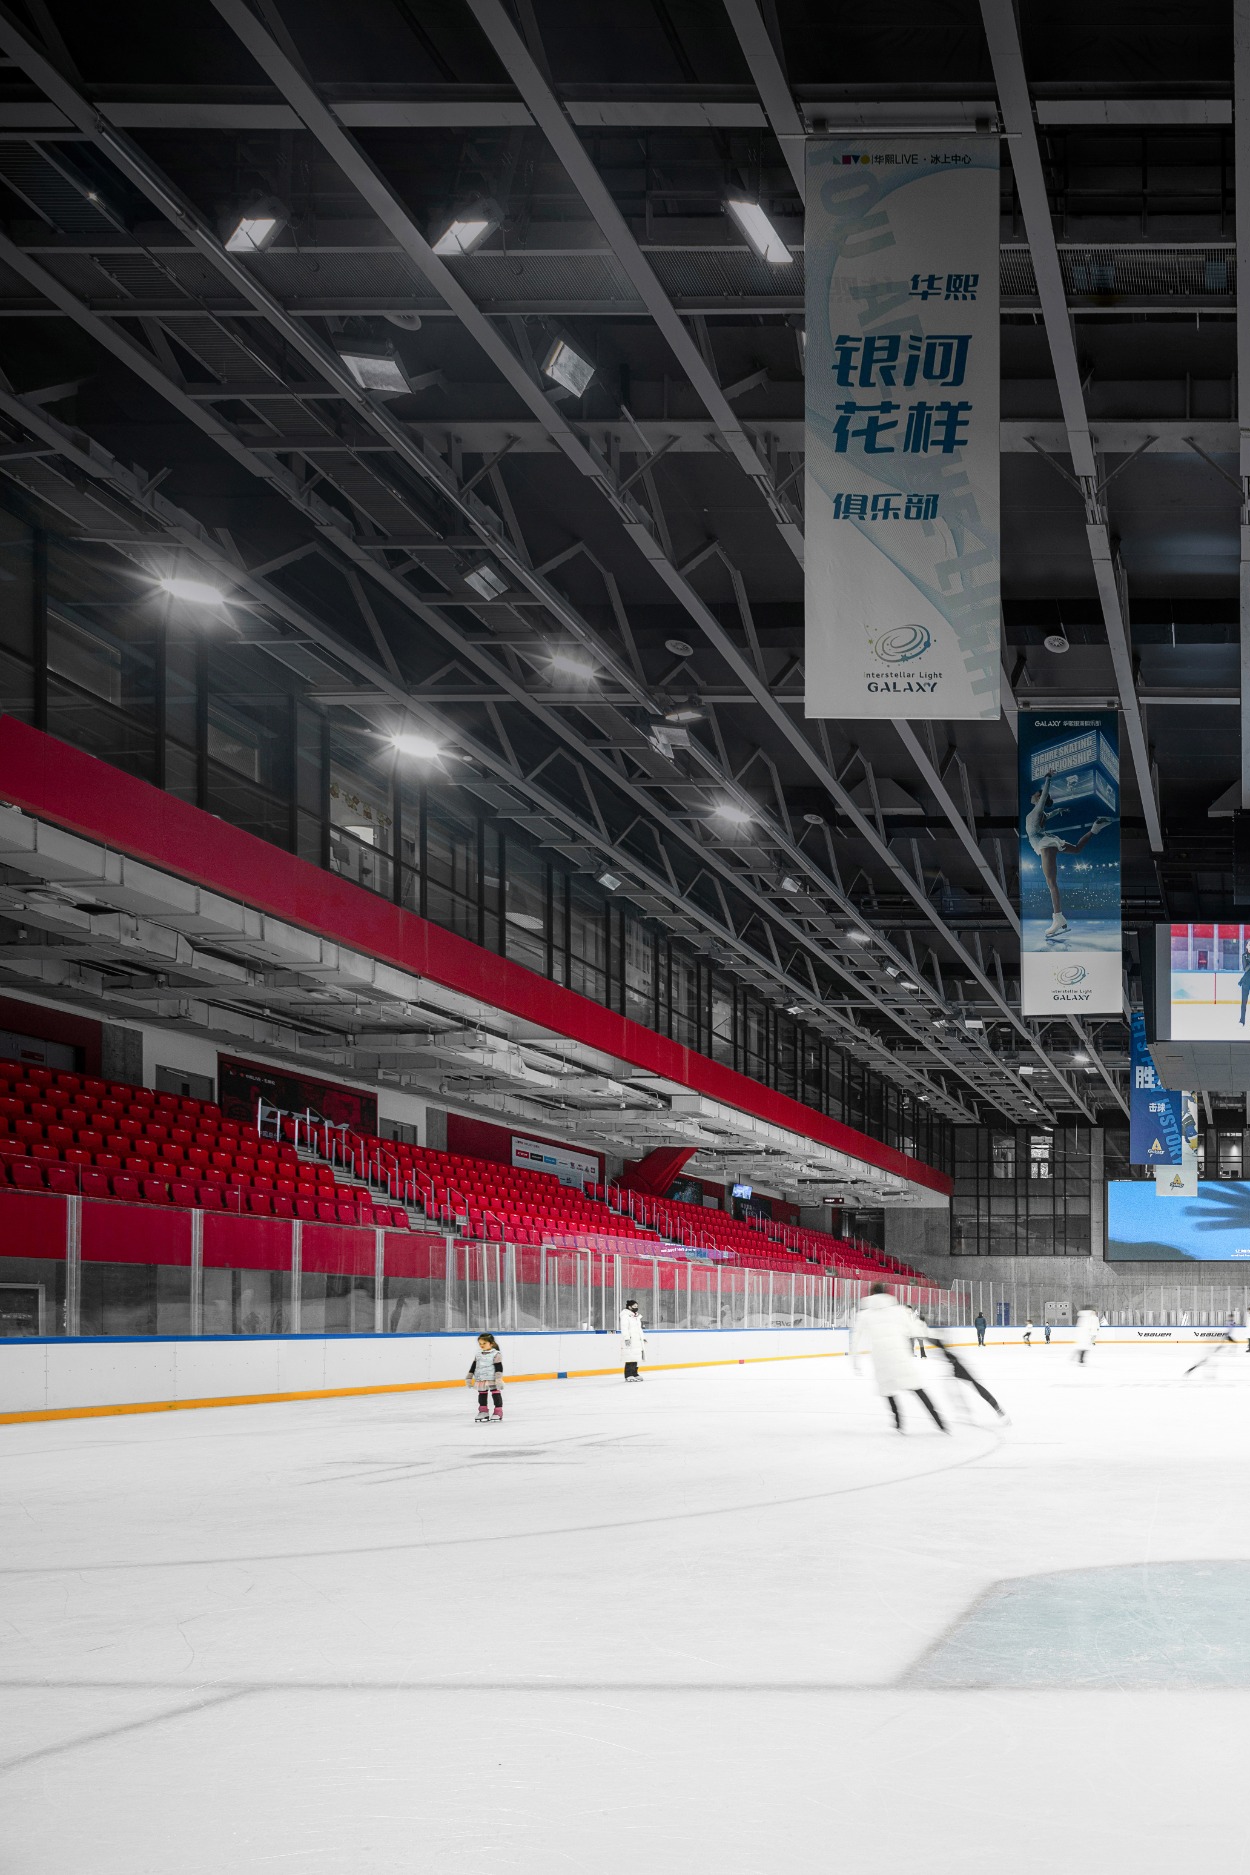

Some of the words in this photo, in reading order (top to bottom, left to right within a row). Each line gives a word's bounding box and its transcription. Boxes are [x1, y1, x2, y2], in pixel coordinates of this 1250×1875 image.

[930, 153, 972, 165] 冰上中心
[908, 273, 980, 301] 华熙
[831, 334, 973, 388] 银河
[832, 400, 973, 454] 花样
[832, 493, 940, 521] 俱乐部
[867, 682, 938, 693] GALAXY
[919, 671, 943, 681] Light
[1034, 720, 1061, 728] GALAXY
[1034, 748, 1059, 766] FIGURE
[1059, 736, 1093, 758] SKATING
[1035, 749, 1093, 778] CHAMPIONSHIP
